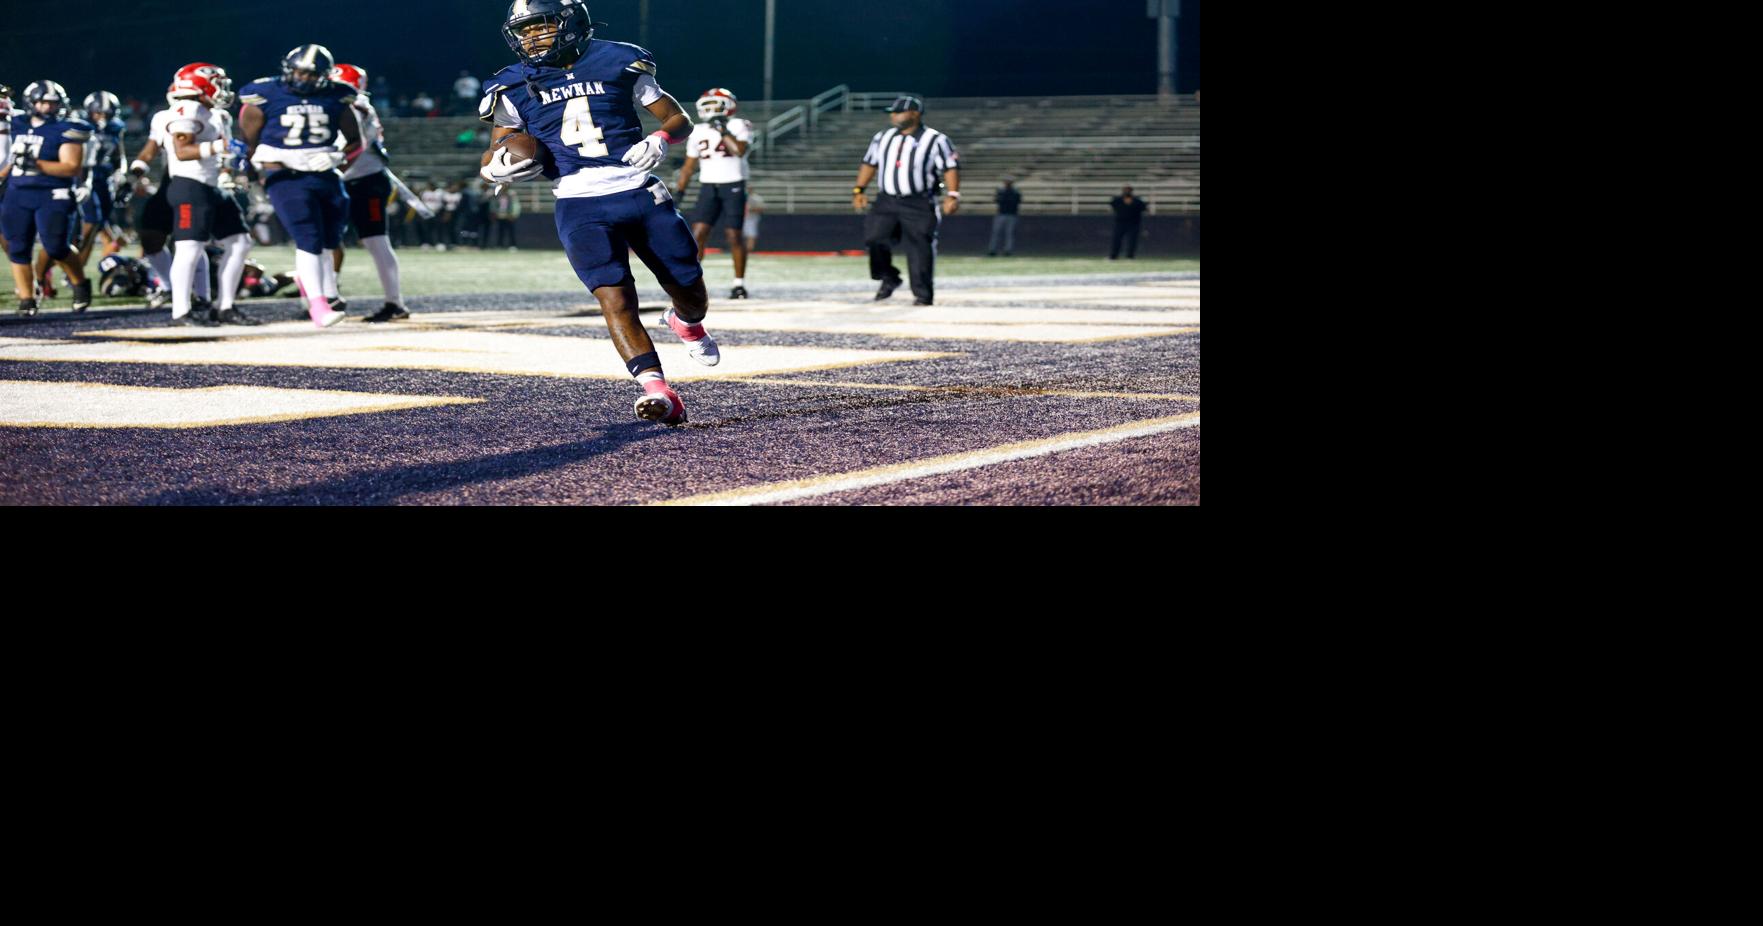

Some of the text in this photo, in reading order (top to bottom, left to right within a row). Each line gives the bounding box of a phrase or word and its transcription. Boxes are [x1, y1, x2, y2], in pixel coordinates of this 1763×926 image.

[539, 81, 606, 105] NEWNAN
[280, 114, 332, 146] 75
[560, 96, 609, 158] 4
[698, 139, 736, 159] 24
